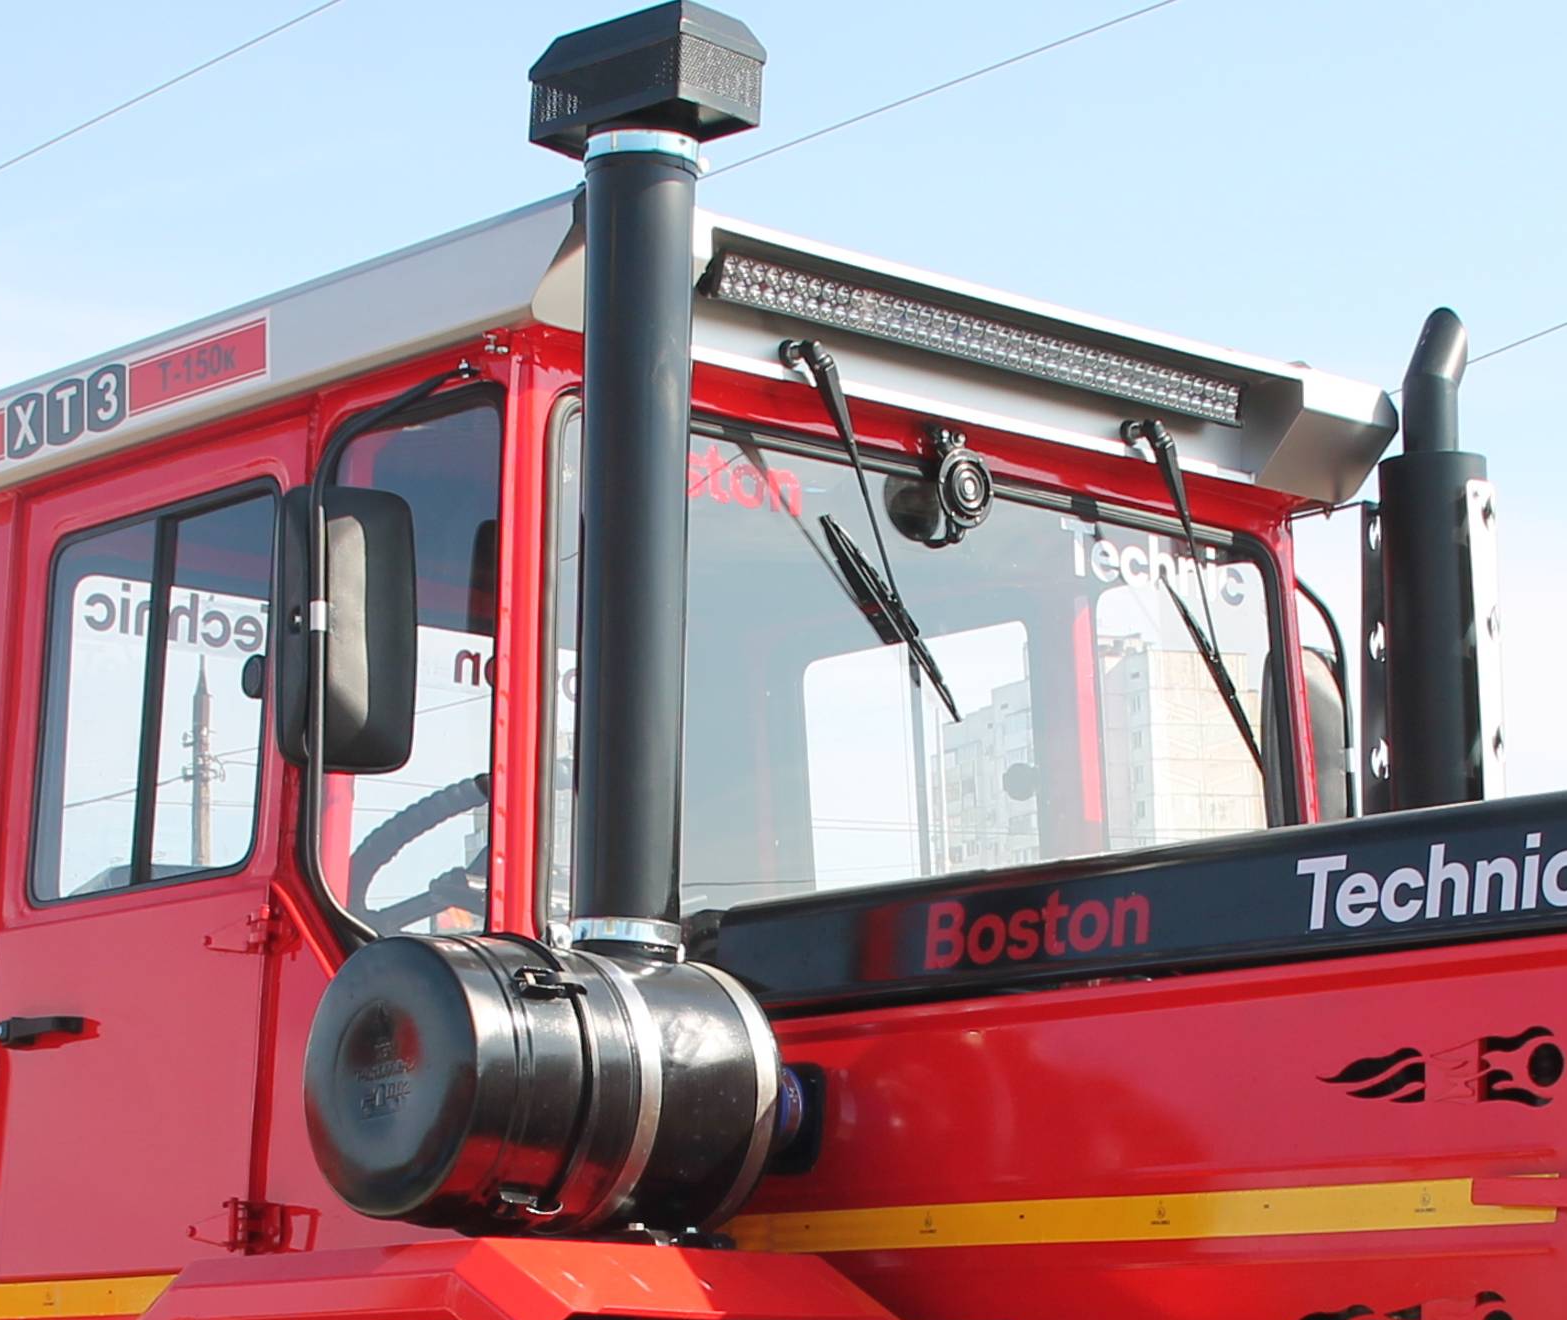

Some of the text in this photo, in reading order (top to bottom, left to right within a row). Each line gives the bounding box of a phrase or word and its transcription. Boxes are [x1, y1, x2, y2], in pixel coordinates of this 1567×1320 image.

[689, 444, 803, 517] ston
[1060, 516, 1245, 606] Technic
[924, 889, 1150, 970] Boston
